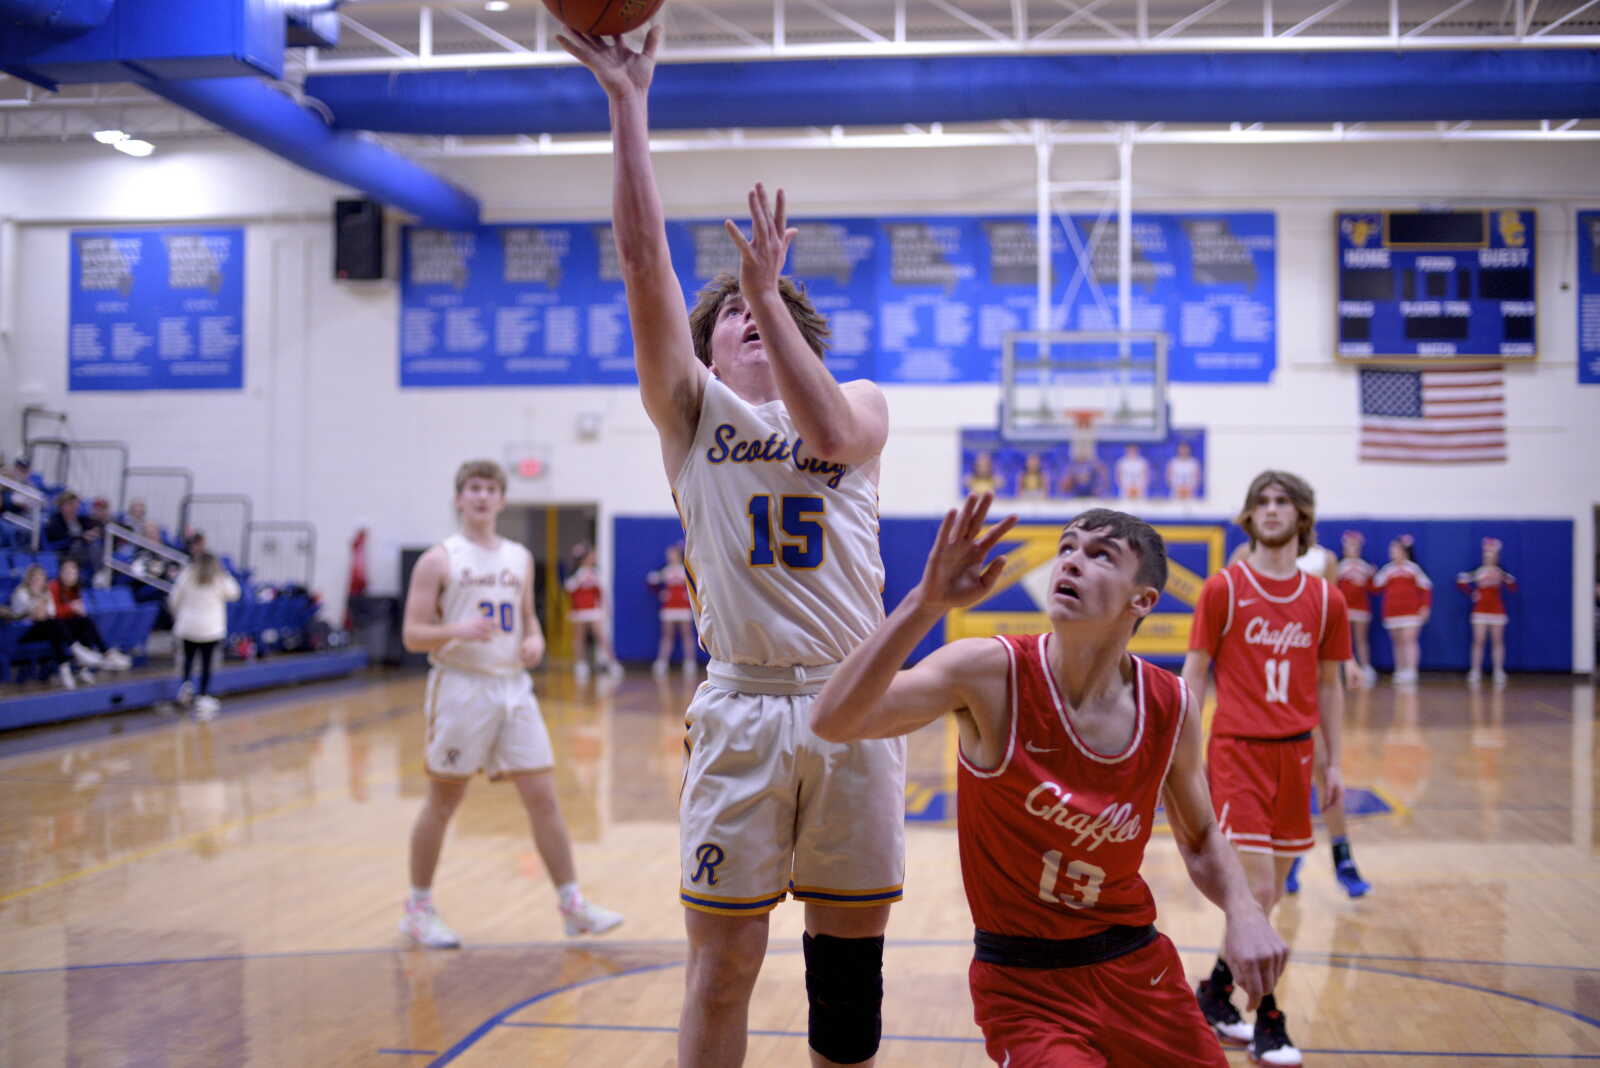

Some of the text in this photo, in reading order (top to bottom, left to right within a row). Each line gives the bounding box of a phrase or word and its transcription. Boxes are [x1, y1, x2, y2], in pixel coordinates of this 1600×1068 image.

[1478, 248, 1529, 267] GUEST
[706, 424, 790, 464] Scott
[746, 494, 827, 571] 15
[1244, 616, 1312, 655] Chaffee
[1264, 659, 1290, 703] 11
[690, 842, 726, 887] R
[1038, 850, 1107, 910] 13
